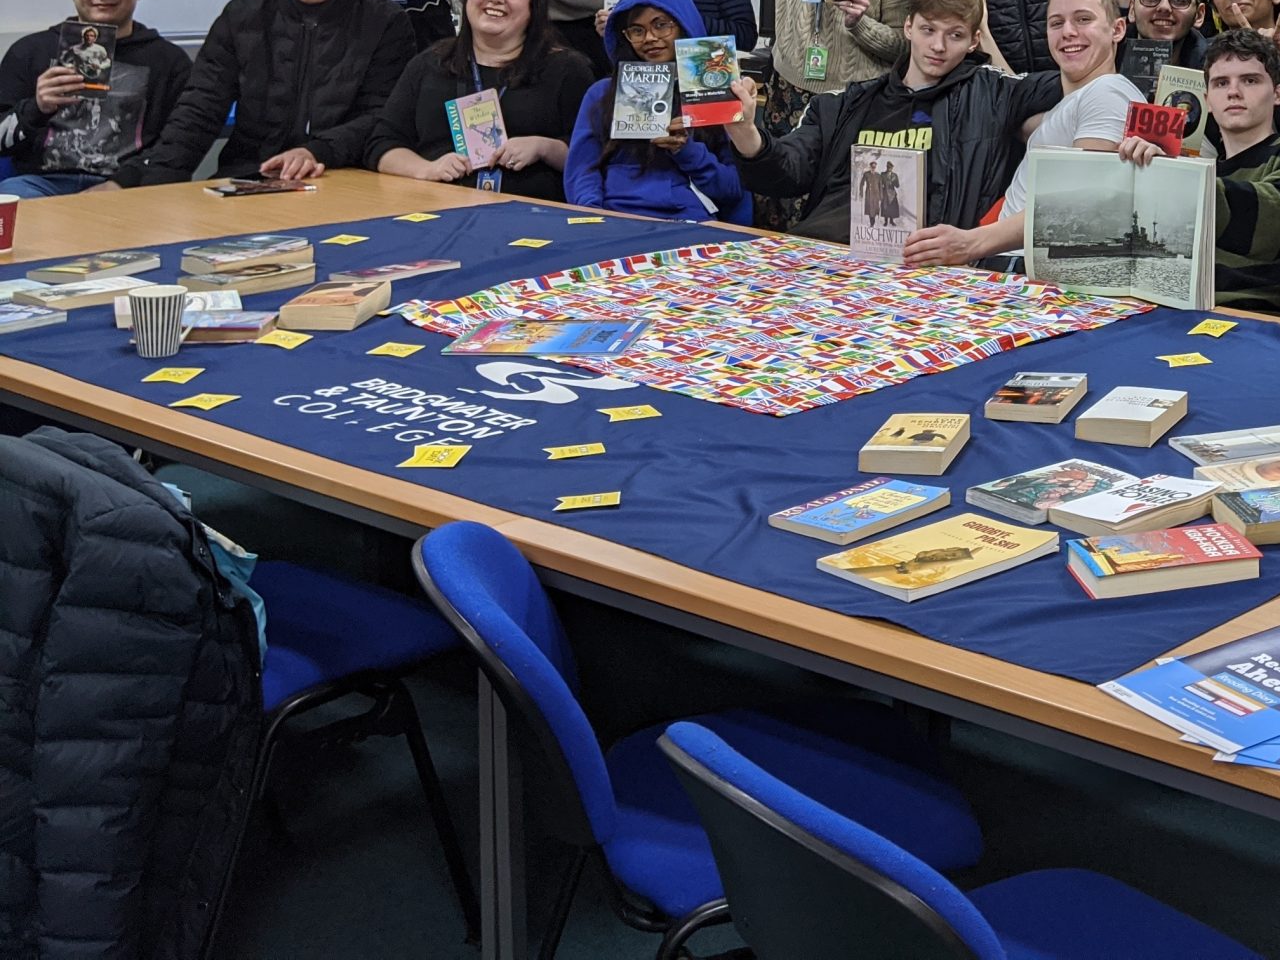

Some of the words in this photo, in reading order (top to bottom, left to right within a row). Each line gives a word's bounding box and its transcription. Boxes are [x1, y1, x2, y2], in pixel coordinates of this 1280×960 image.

[623, 63, 654, 72] GEORGE
[621, 71, 671, 83] MARTIN
[617, 121, 666, 132] DRAGON
[1128, 106, 1184, 140] 1984
[314, 386, 349, 397] &
[342, 392, 504, 439] TAUNTON
[351, 377, 538, 430] BRIDGWATER
[273, 394, 464, 447] COLEGE
[1106, 488, 1172, 504] ROYALE
[1128, 483, 1192, 499] CASINO
[962, 521, 1014, 539] GOODBYE
[974, 534, 1020, 550] POLSKO
[1199, 527, 1240, 556] МОСКВА
[1216, 674, 1253, 694] Reading
[1252, 689, 1278, 706] Diary
